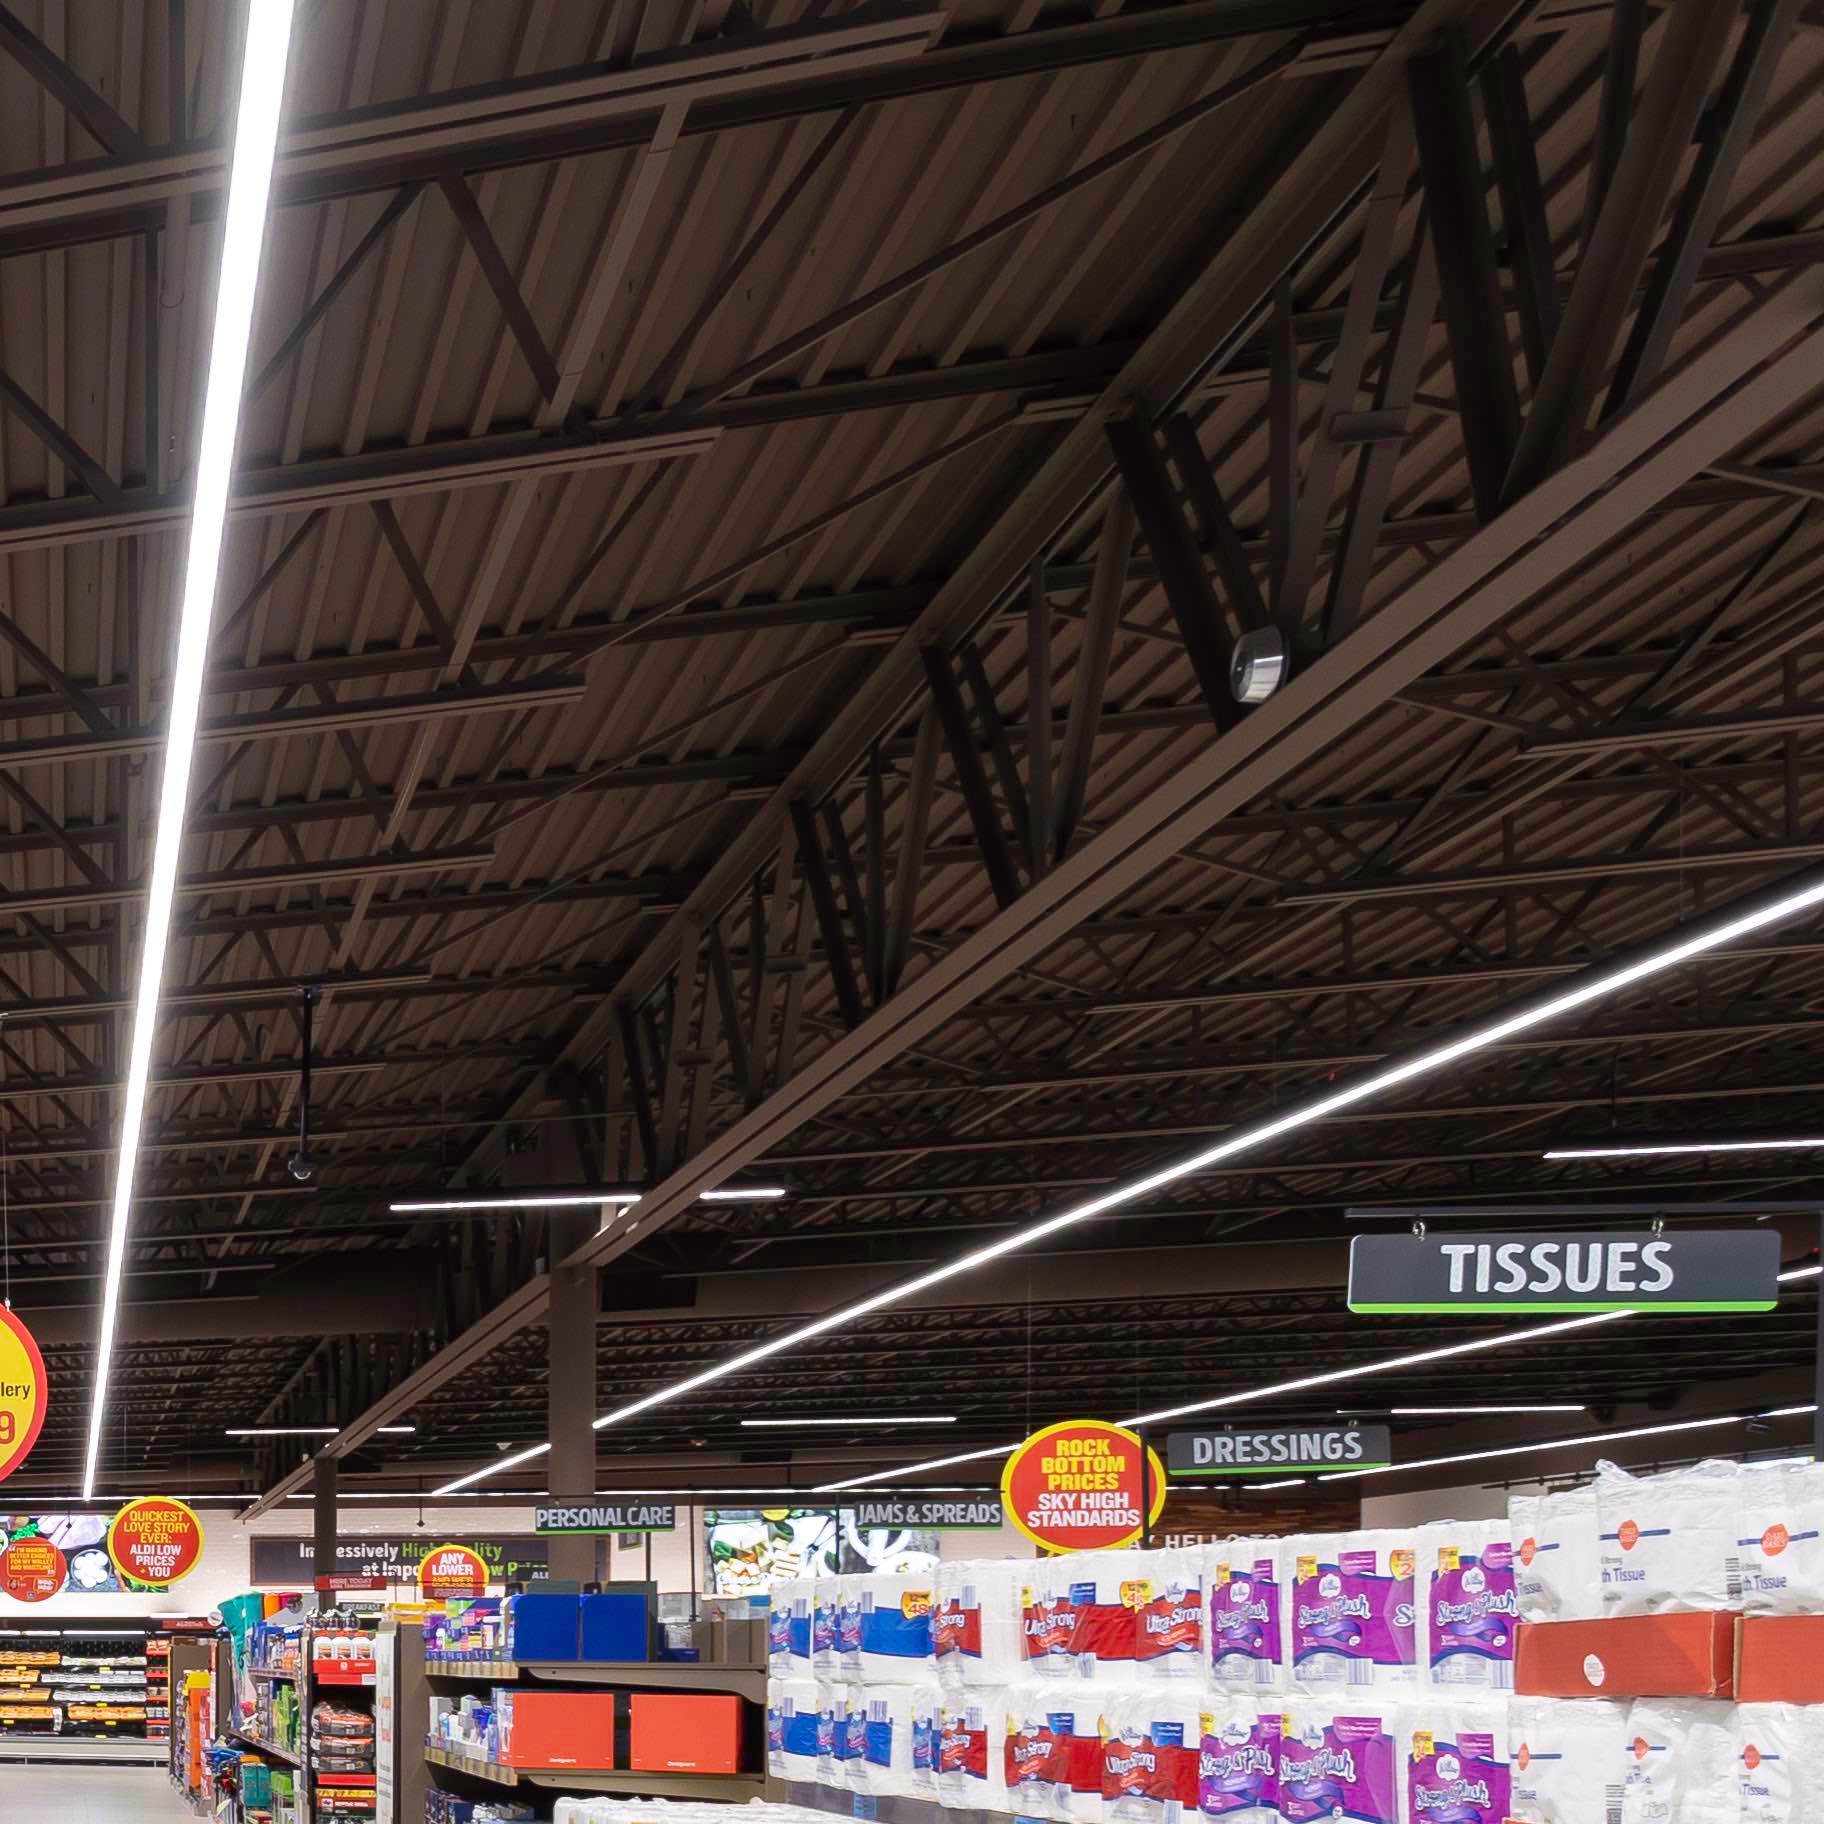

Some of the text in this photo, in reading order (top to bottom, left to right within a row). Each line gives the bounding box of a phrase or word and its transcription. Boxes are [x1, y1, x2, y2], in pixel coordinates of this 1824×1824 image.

[1440, 1241, 1675, 1294] TISSUES
[1056, 1439, 1111, 1457] ROCK
[1193, 1431, 1363, 1465] DRESSINGS
[1041, 1455, 1125, 1475] BOTTOM
[1048, 1473, 1120, 1491] PRICES
[1038, 1493, 1129, 1510] SKY HIGH
[129, 1511, 185, 1522] QUICKEST
[535, 1505, 674, 1529] PERSONAL CARE
[857, 1503, 1001, 1525] JAMS & SPREADS
[1027, 1509, 1141, 1528] STANDARDS
[123, 1522, 190, 1533] LOVE STORY
[140, 1532, 172, 1543] EVER:
[129, 1544, 182, 1555] ALDI LOW
[135, 1555, 176, 1567] PRICES
[439, 1553, 465, 1565] ANY
[147, 1567, 171, 1577] YOU
[432, 1564, 474, 1576] LOWER
[1613, 1567, 1646, 1583] Tissue
[1754, 1574, 1787, 1591] Tissue
